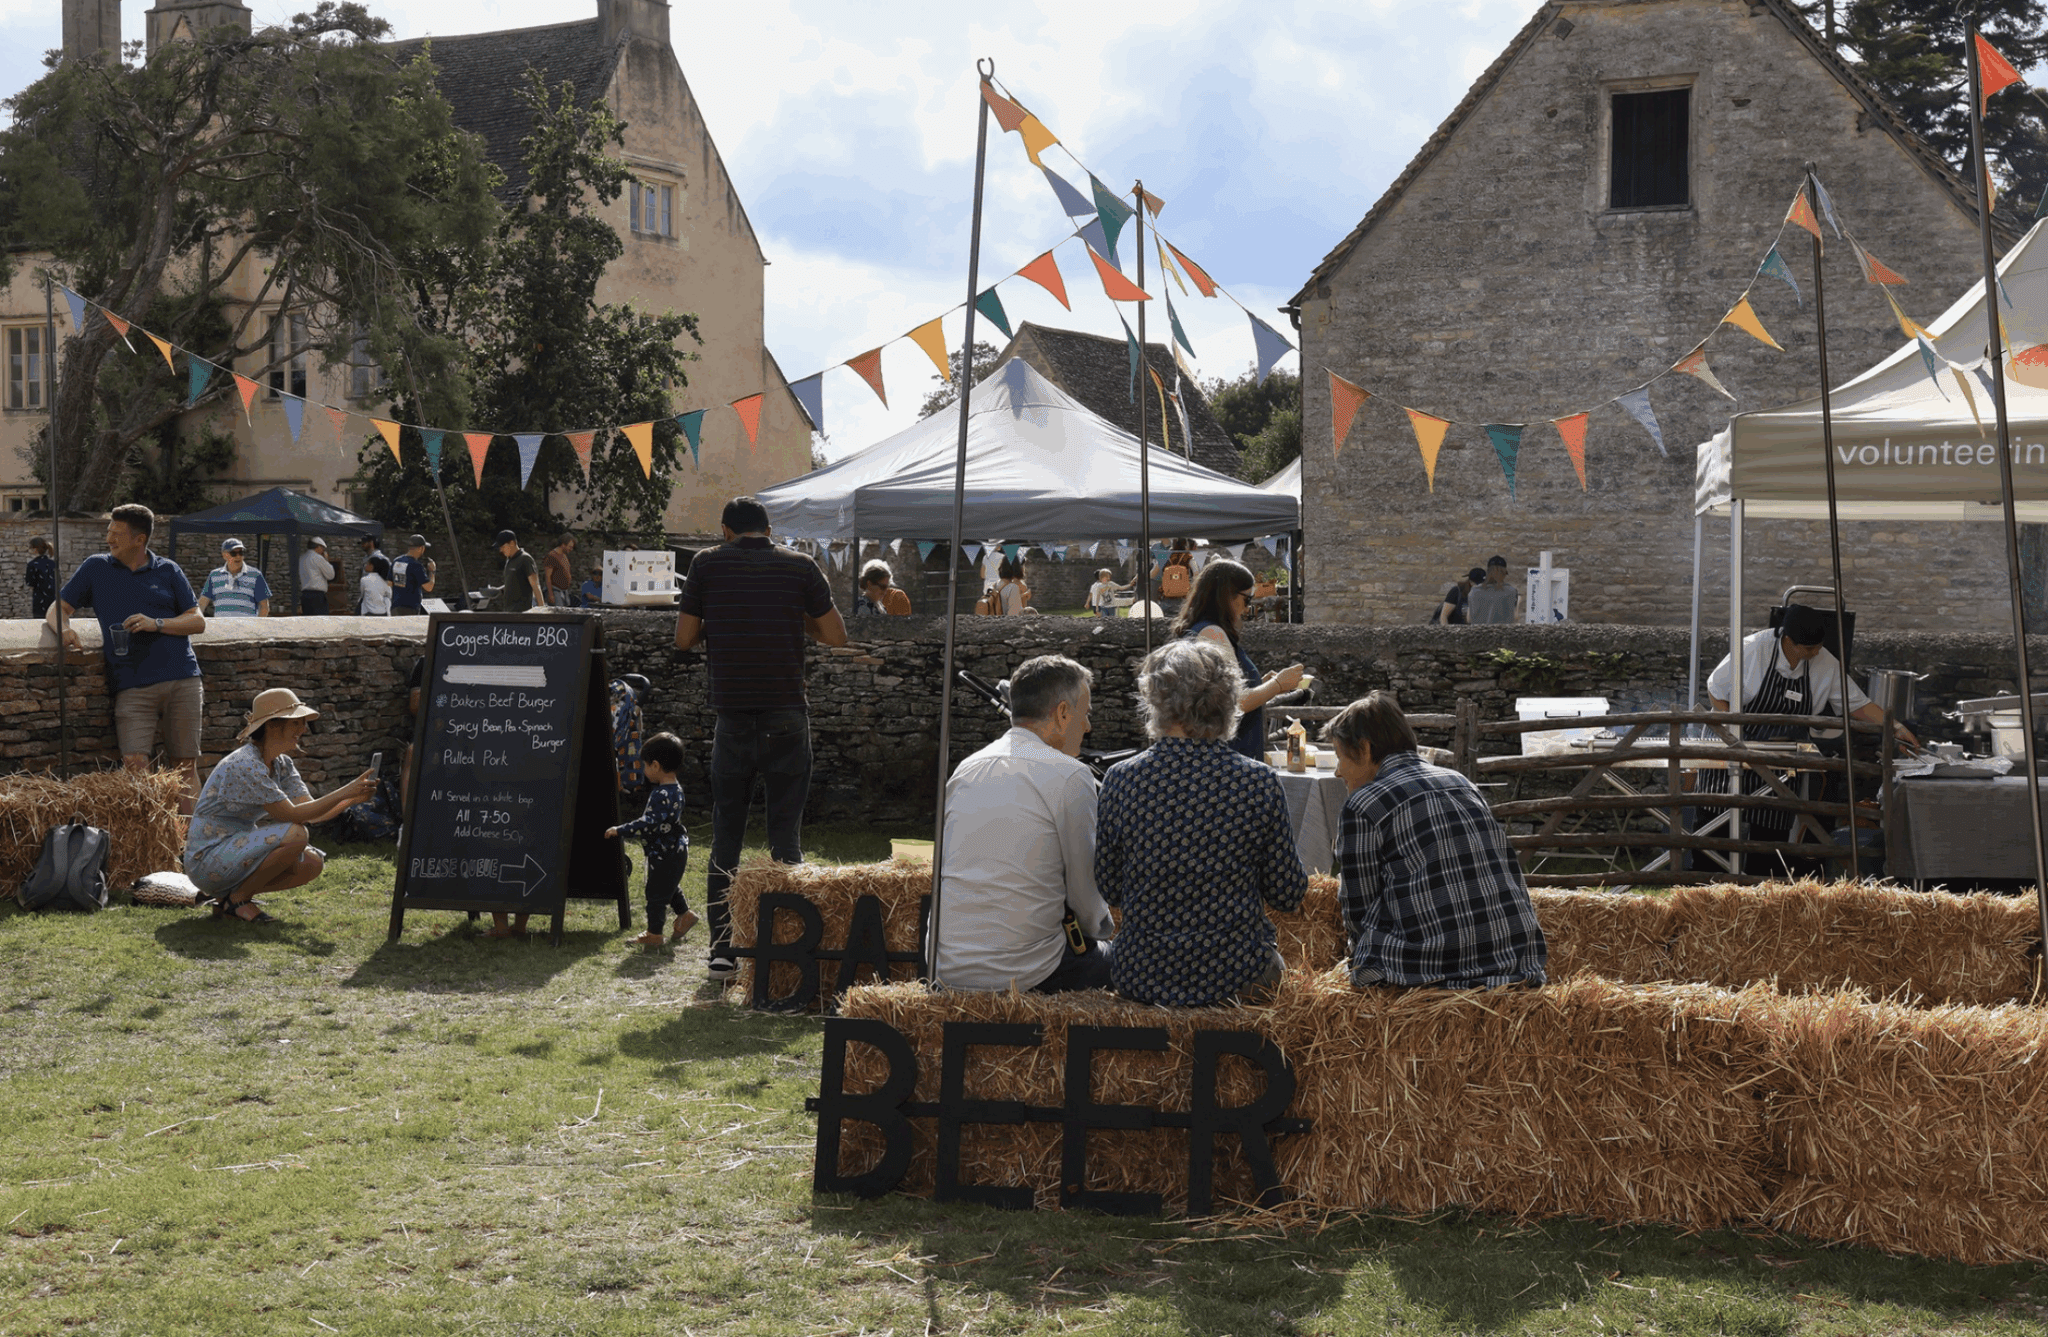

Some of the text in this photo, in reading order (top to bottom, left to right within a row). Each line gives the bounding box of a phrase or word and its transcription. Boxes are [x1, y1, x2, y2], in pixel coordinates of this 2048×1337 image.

[1837, 436, 2045, 466] volunteein
[441, 626, 569, 656] Cogges Kitchen BBQ
[450, 692, 556, 713] Bakers Beef Burger
[446, 719, 479, 739] Spicy
[482, 719, 504, 735] Bean,
[505, 719, 517, 732] Pea
[521, 719, 553, 736] Spinach
[532, 735, 566, 753] Burger
[443, 750, 509, 767] Pulled Pork
[430, 790, 443, 801] All
[446, 790, 471, 803] Served
[472, 794, 481, 803] in
[482, 795, 489, 803] a
[518, 793, 534, 808] bap
[455, 809, 470, 823] All
[453, 826, 524, 844] Add Cheese 50p
[410, 858, 499, 879] PLEASE QUEUE
[812, 1017, 1295, 1216] BEER
